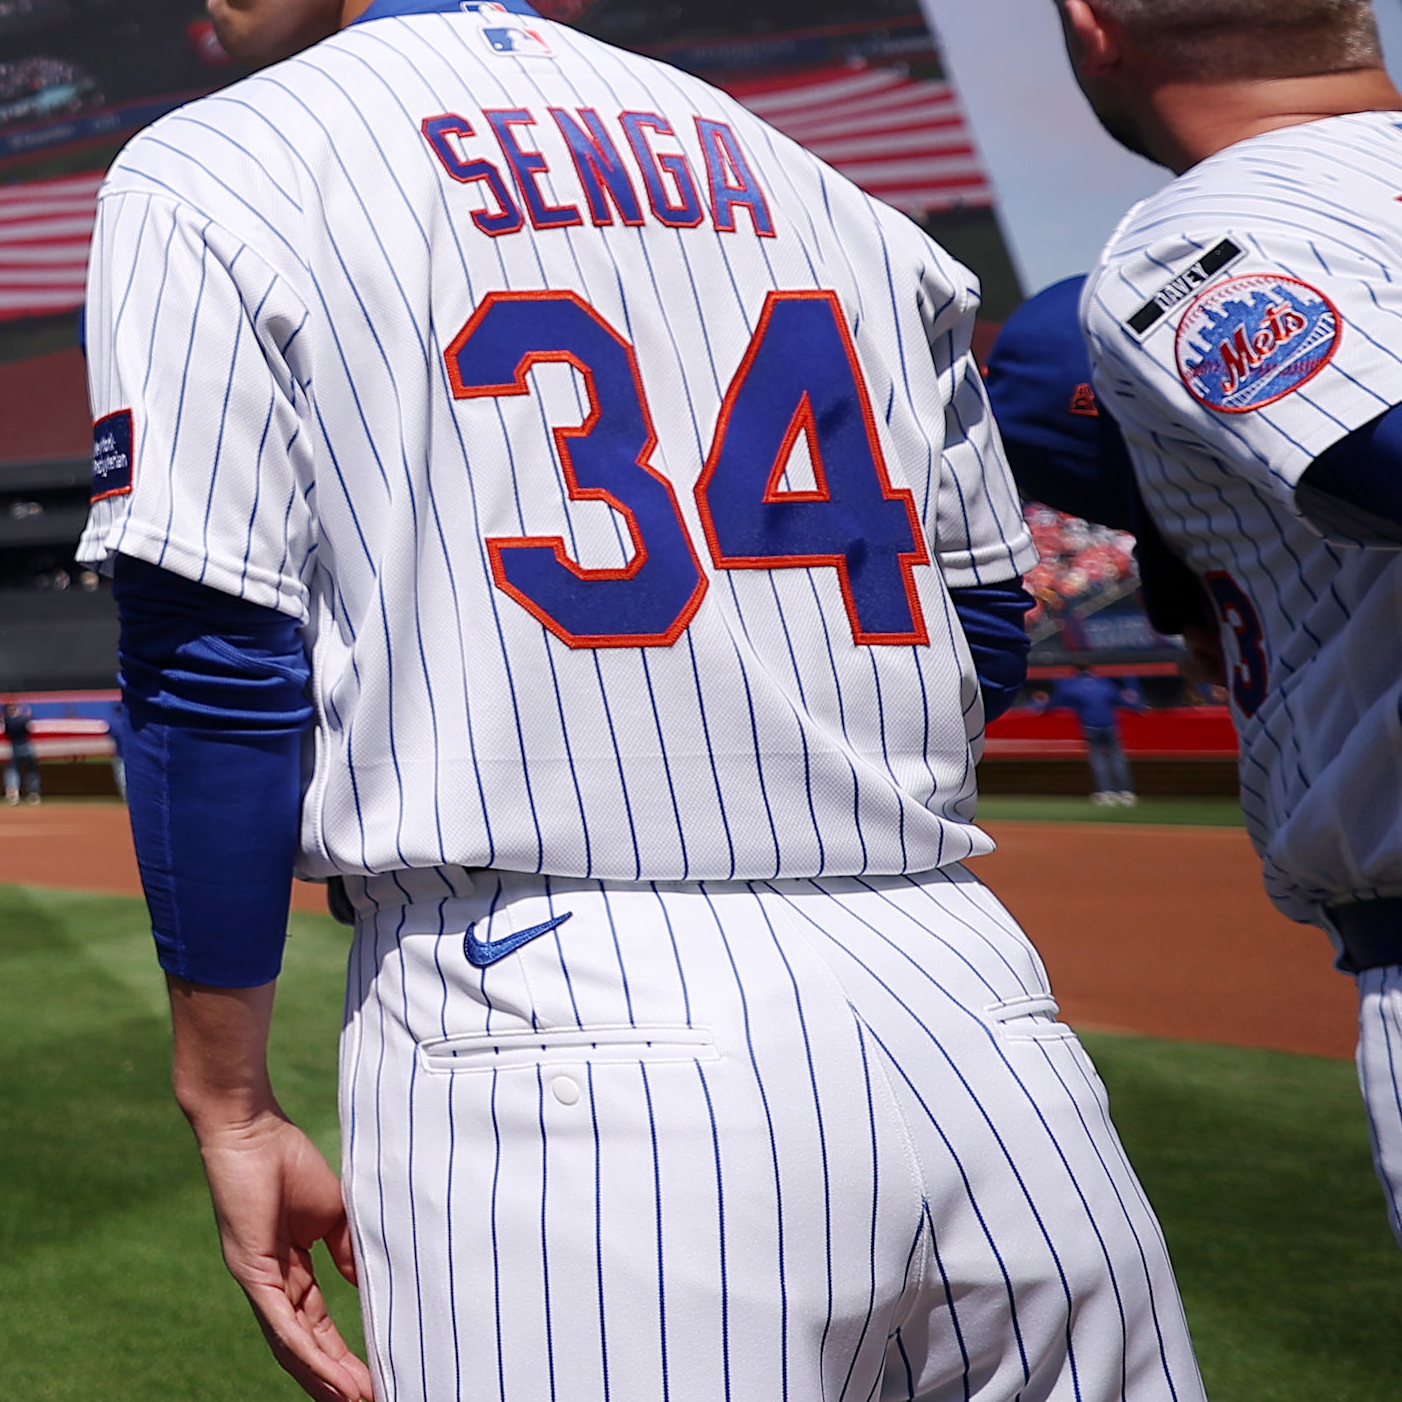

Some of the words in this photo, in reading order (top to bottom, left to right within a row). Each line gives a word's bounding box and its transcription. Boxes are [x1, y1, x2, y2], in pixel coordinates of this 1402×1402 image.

[421, 108, 777, 238] SENGA
[1154, 262, 1210, 311] DAVEY
[1221, 300, 1308, 394] Mets
[444, 289, 930, 648] 34
